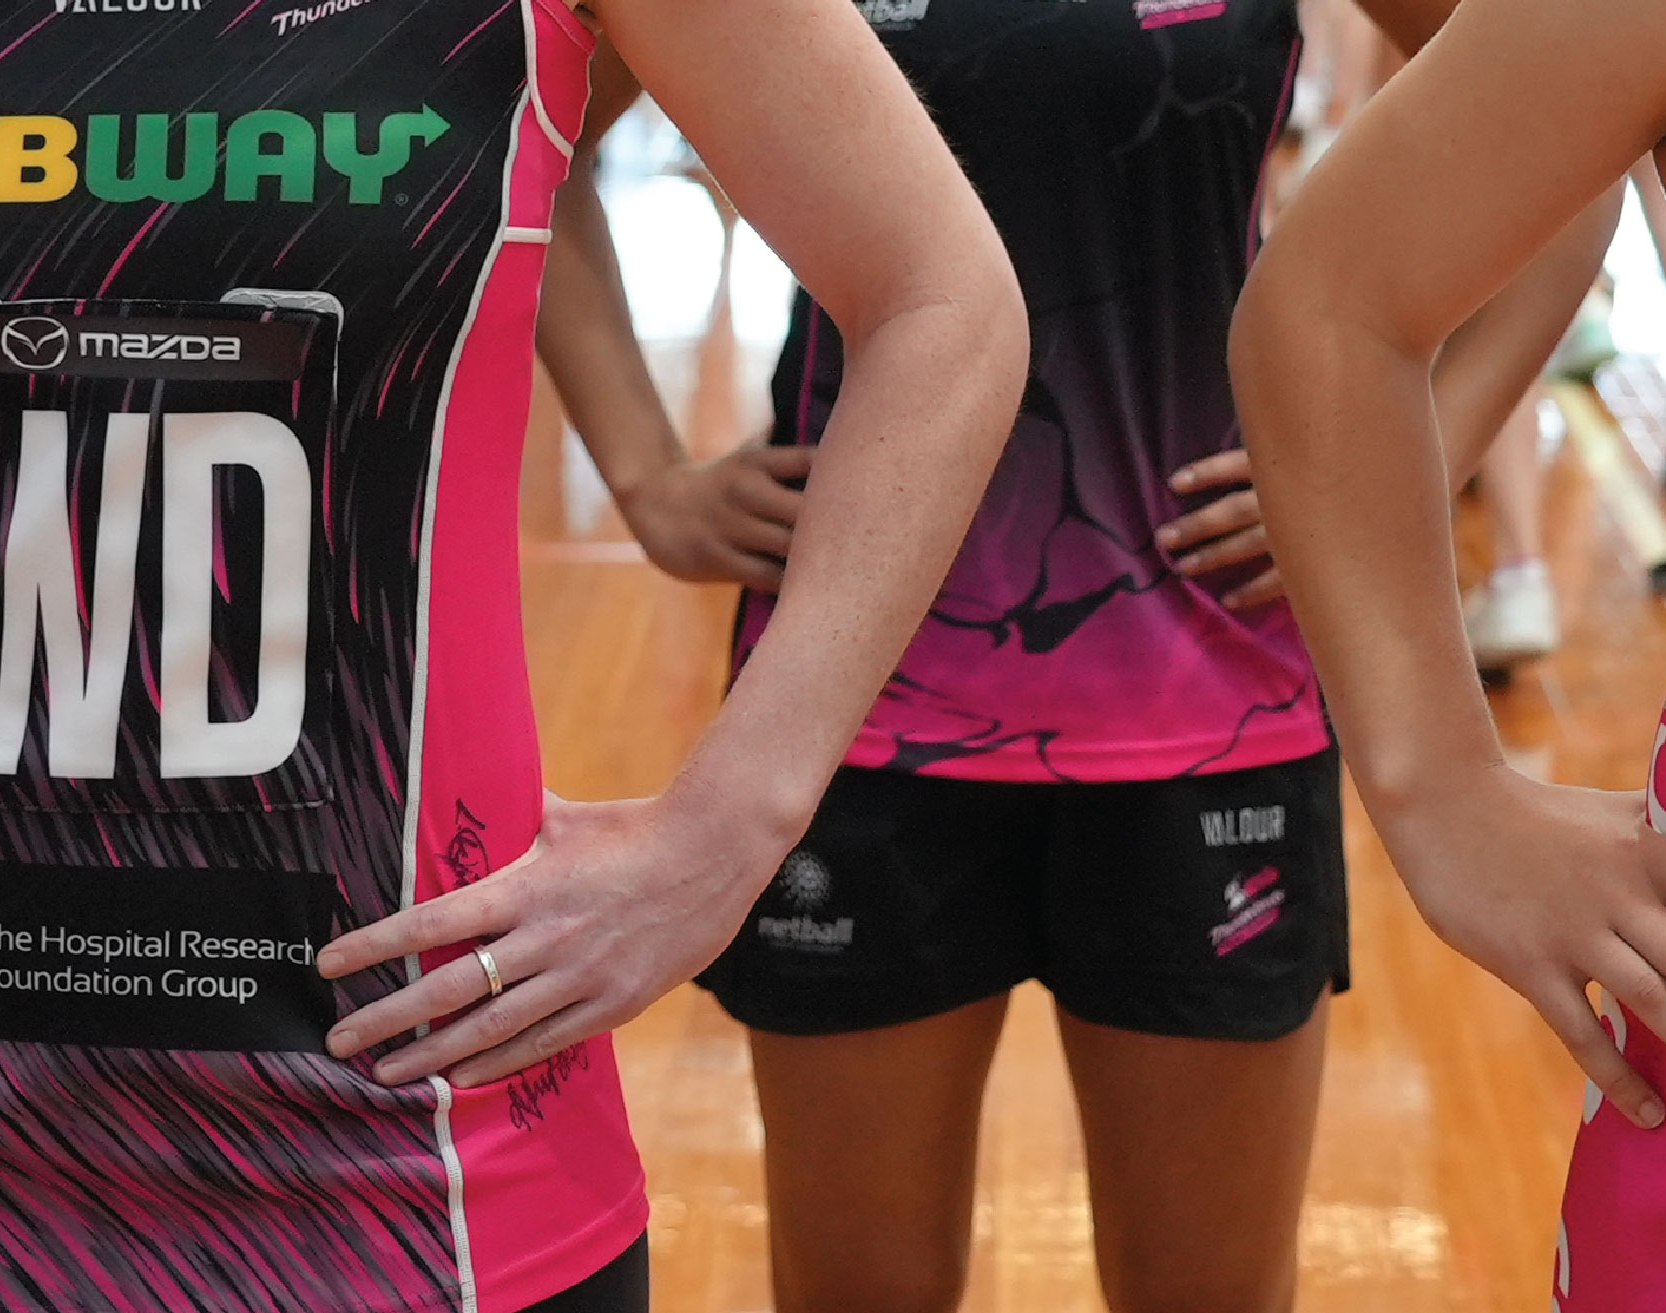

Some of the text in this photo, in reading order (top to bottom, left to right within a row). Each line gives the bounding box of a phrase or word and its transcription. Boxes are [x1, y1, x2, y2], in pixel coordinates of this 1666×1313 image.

[41, 924, 171, 963] Hospital
[179, 930, 317, 966] Research
[161, 969, 259, 1005] Group
